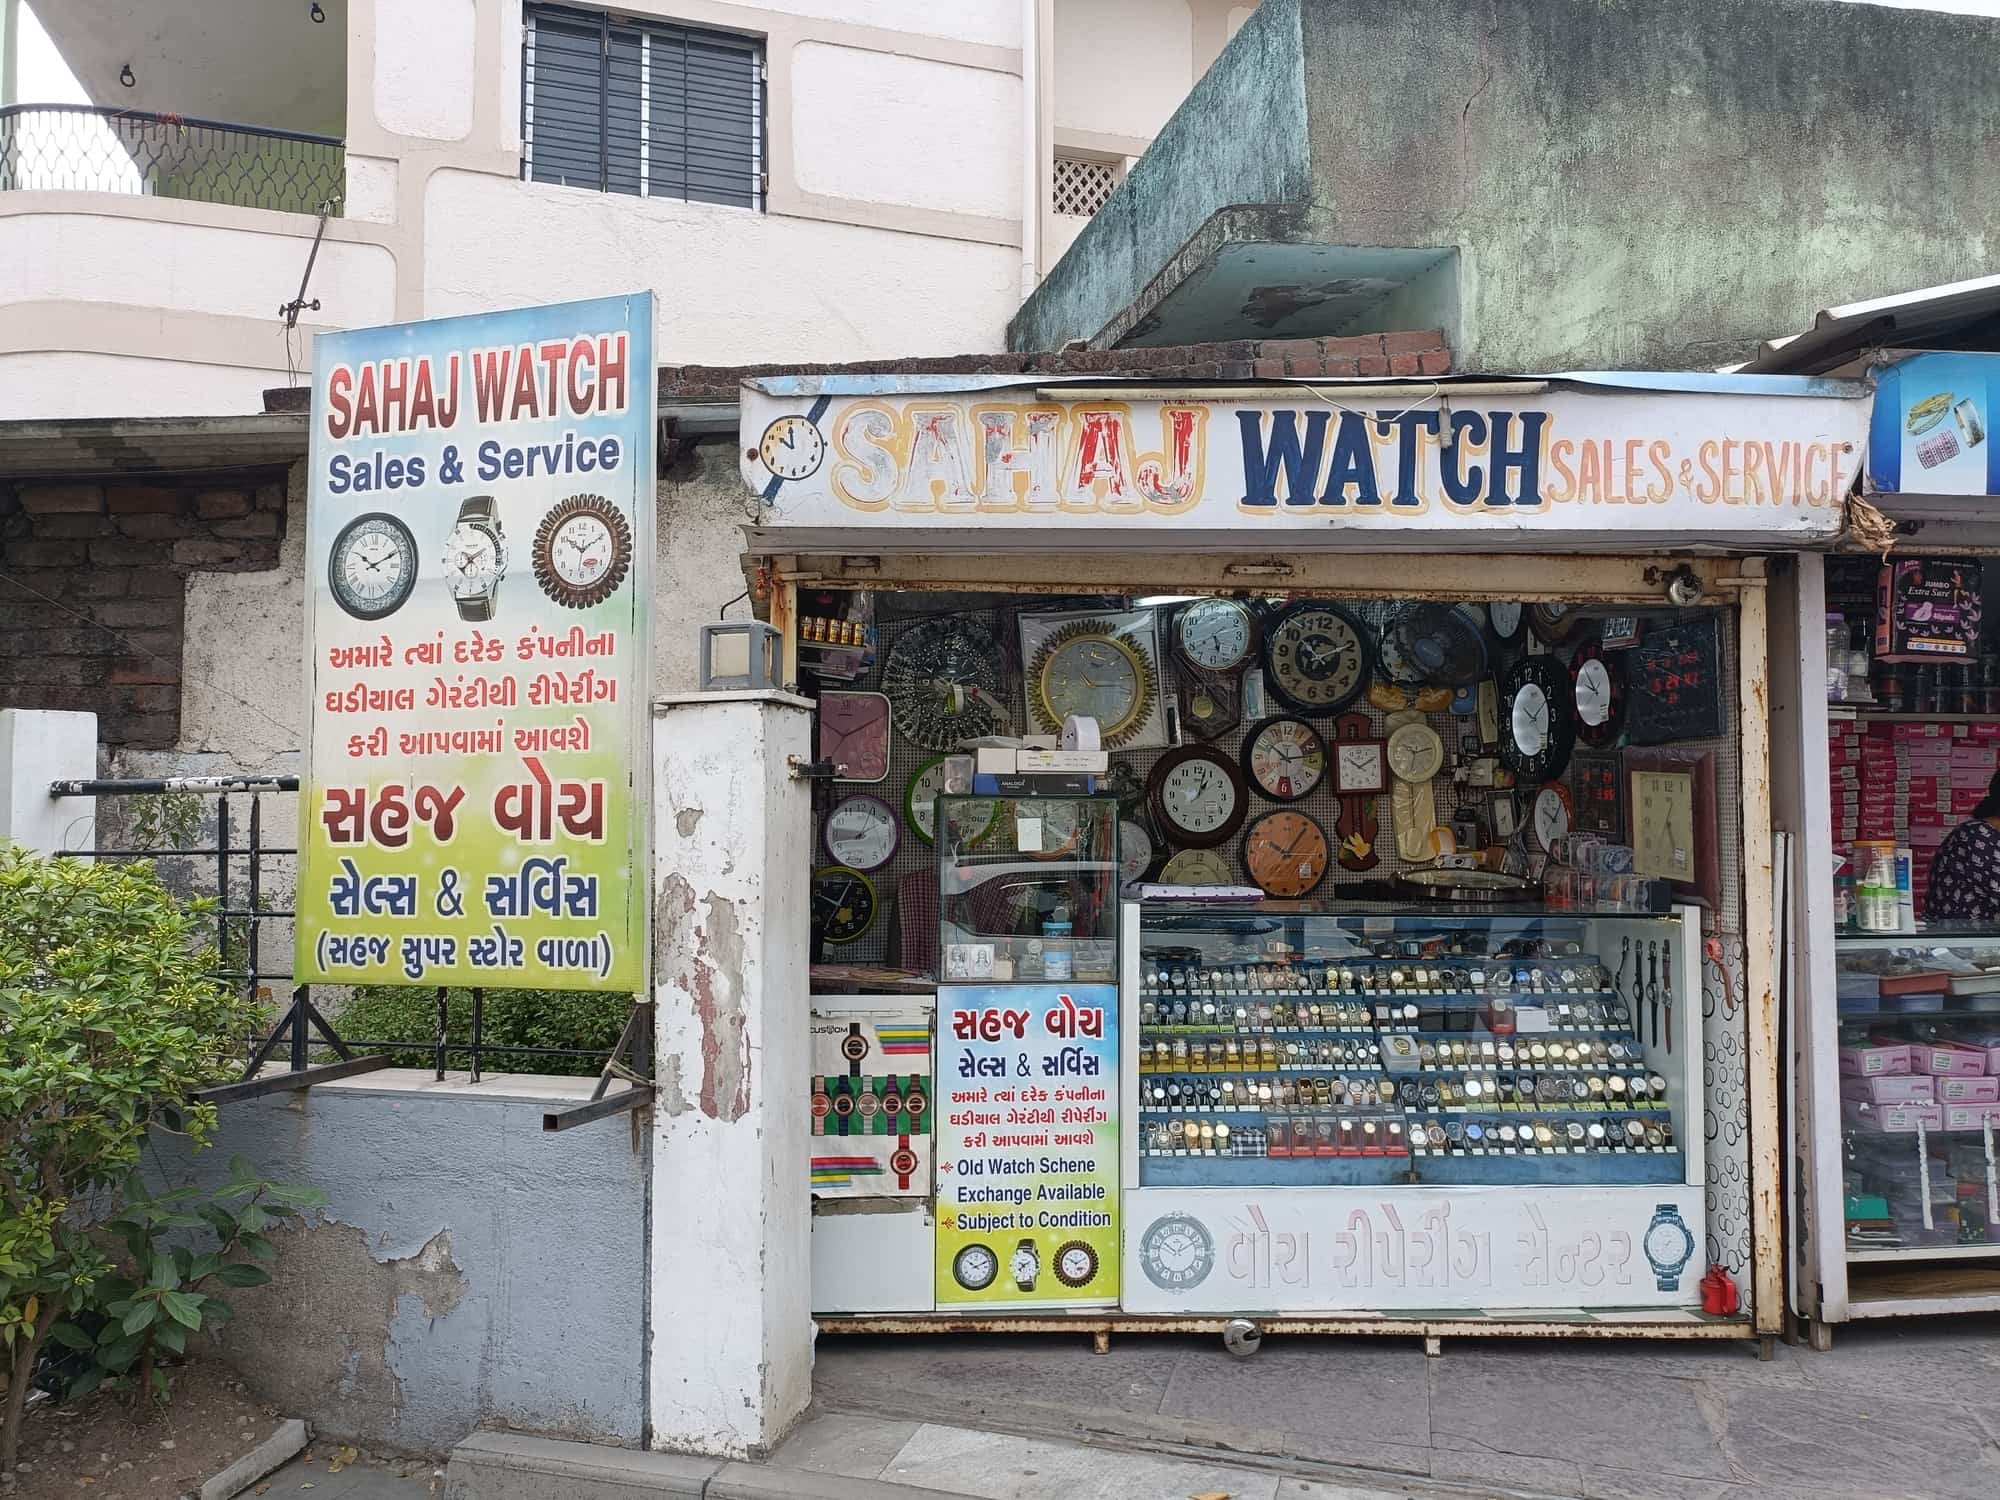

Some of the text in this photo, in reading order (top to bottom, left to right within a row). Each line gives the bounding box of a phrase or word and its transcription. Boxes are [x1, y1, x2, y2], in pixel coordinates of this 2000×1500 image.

[328, 336, 625, 439] SAHAJ WATCH
[328, 433, 620, 494] Sales & Service
[833, 403, 1207, 514] SAHAJ
[1236, 410, 1549, 511] WATCH
[1547, 440, 1673, 504] SALES
[1697, 440, 1848, 506] SERVICE
[330, 625, 615, 668] અમારે ત્યાં દરેક કંપનીના
[326, 683, 415, 713] ઘડીયાલ
[426, 675, 516, 709] ગેરંટીથી
[348, 717, 590, 757] કરી આપવામાં આવશે
[323, 757, 603, 847] સહજ વોચ
[330, 857, 597, 917] સેલ્સ & સર્વિસ
[317, 926, 610, 978] (સહજ સુપર સ્ટોર વાળા)
[953, 996, 1103, 1042] સહજ વોચ
[958, 1047, 1099, 1077] સેલ્સ & સર્વિસ
[952, 1087, 987, 1103] અમારે
[1021, 1086, 1048, 1102] દરેક
[1054, 1085, 1105, 1101] કંપનીના
[963, 1132, 986, 1148] કરી
[1054, 1129, 1094, 1145] આવશે
[958, 1157, 1095, 1175] Old Watch Schene
[958, 1184, 1105, 1205] Exchange Available
[958, 1210, 1111, 1233] Subject to Condition
